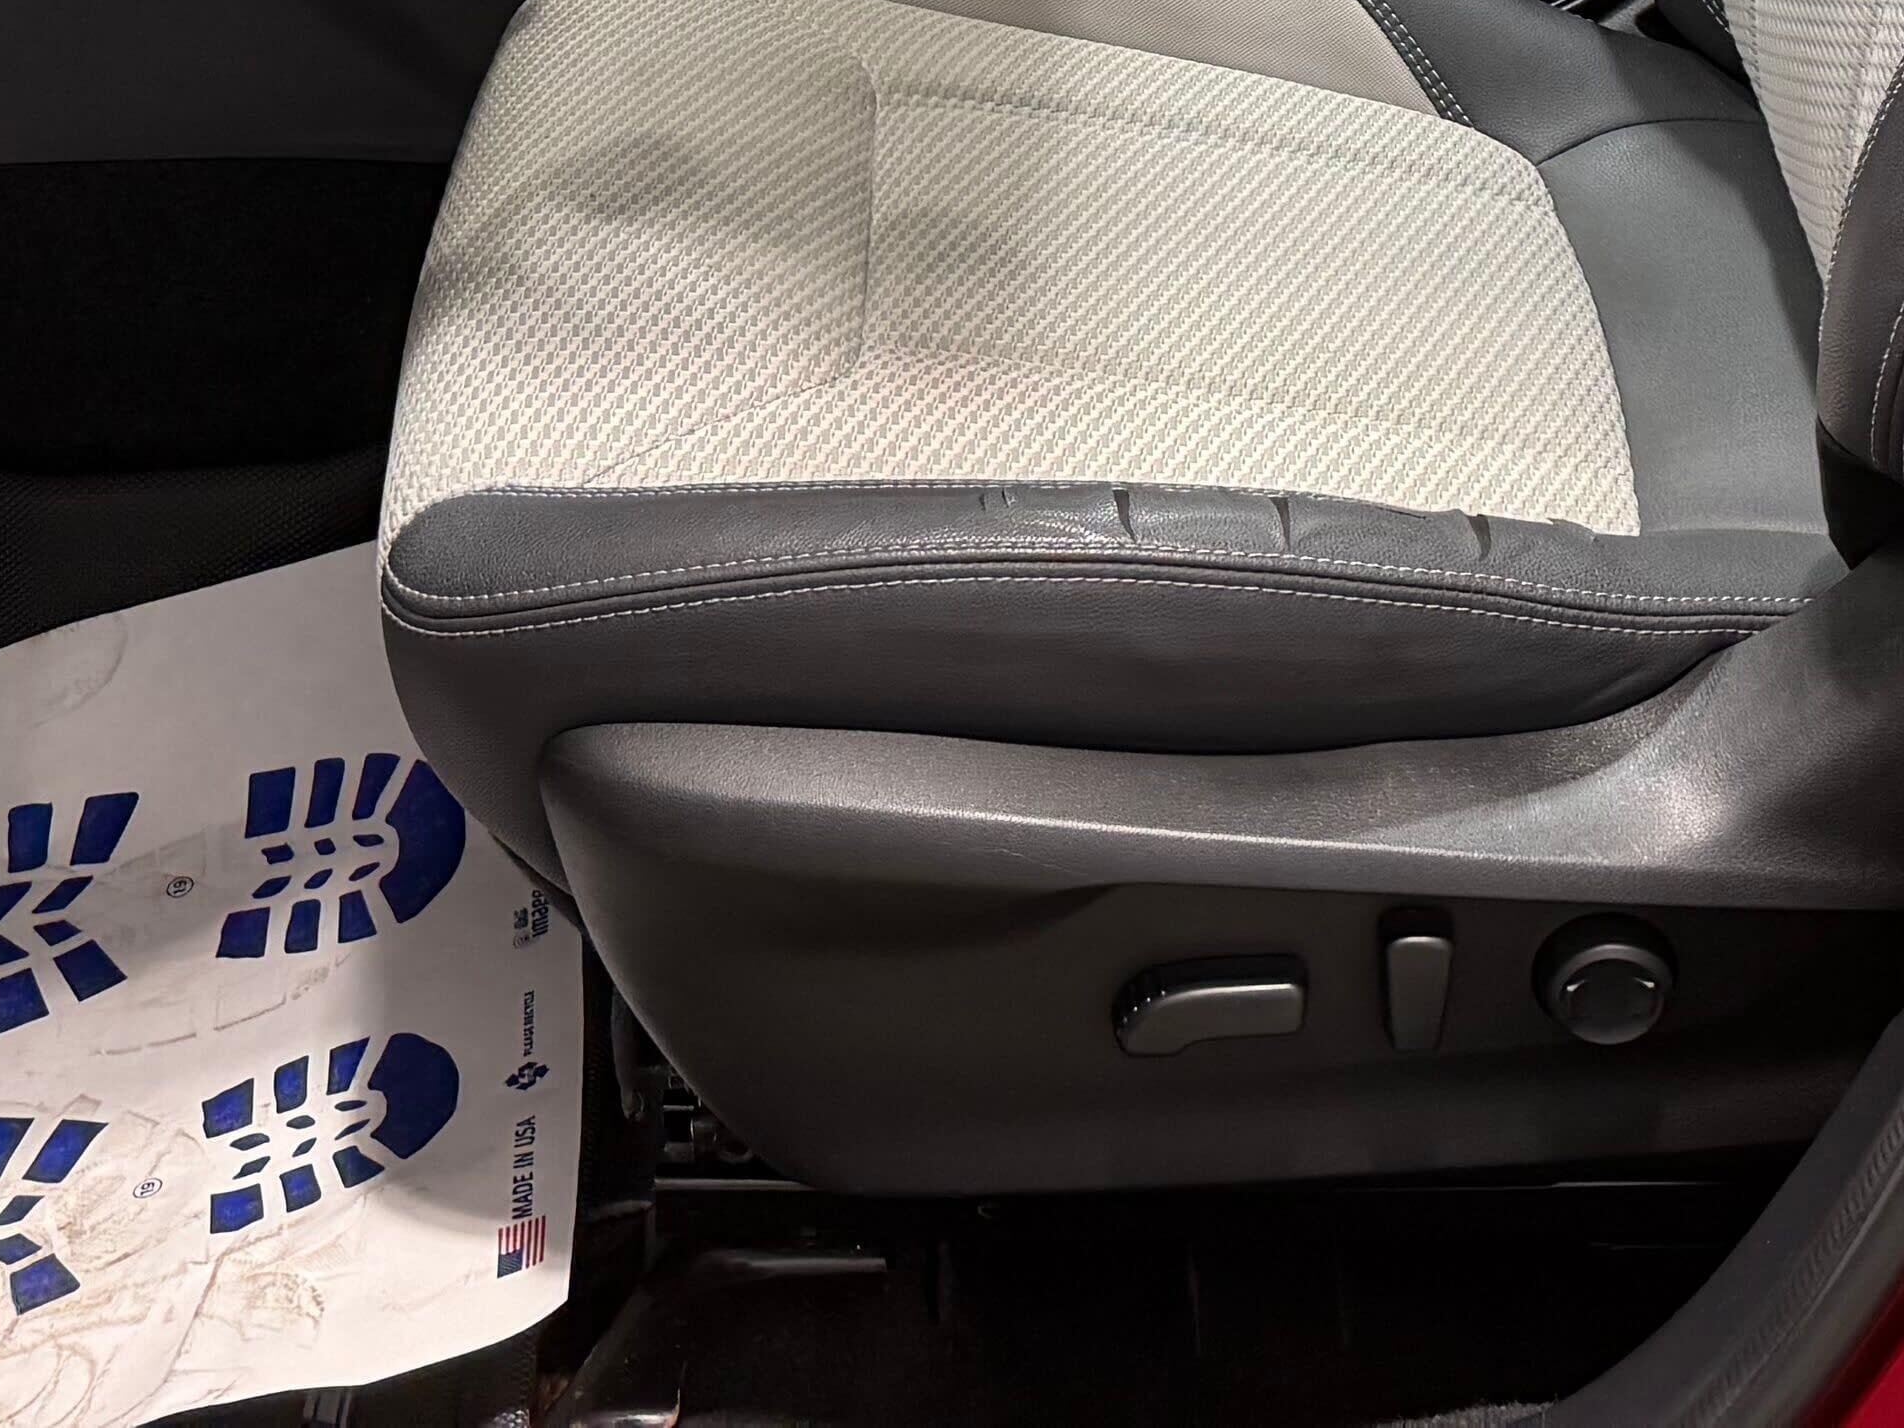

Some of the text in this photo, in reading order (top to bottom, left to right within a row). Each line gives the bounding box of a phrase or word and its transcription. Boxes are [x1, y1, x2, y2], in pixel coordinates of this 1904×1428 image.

[512, 1114, 537, 1220] MADE IN USA
